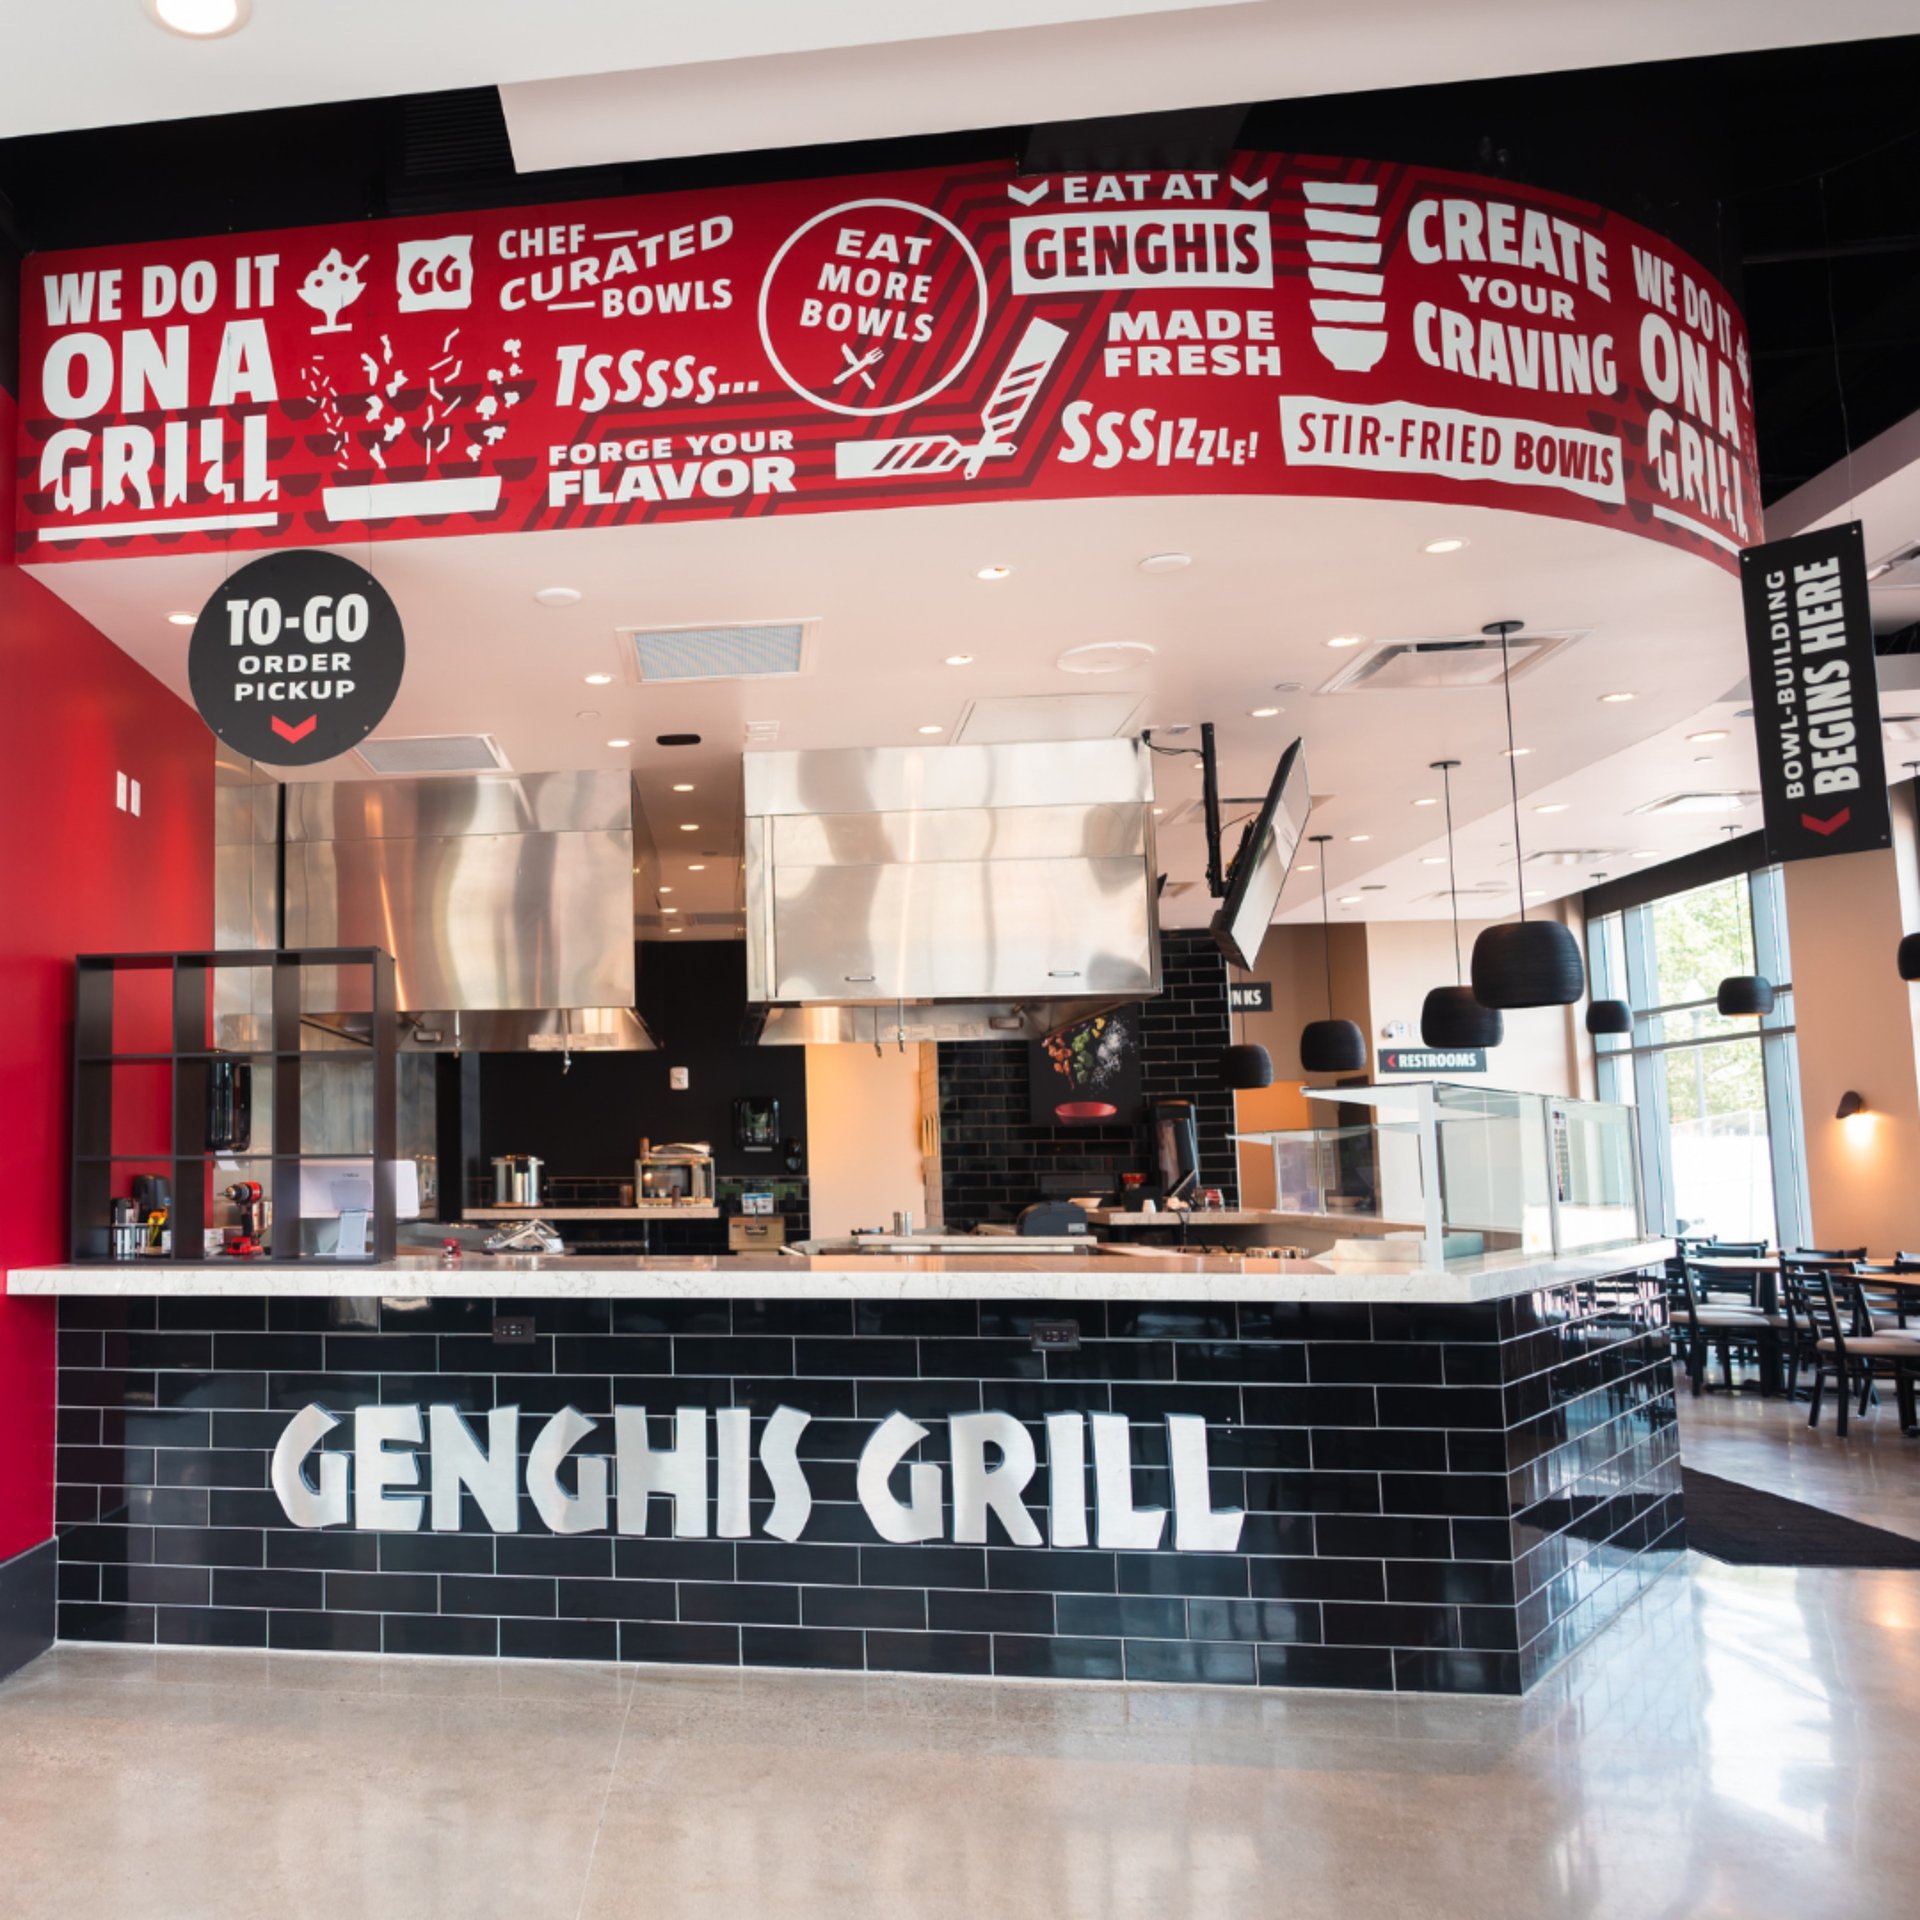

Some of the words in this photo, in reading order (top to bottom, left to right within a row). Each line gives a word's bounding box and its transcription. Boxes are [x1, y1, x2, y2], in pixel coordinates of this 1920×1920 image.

[1063, 173, 1151, 204] EAT
[1162, 173, 1219, 200] AT
[499, 223, 586, 260] CHEF
[499, 215, 734, 312] CURATED
[835, 228, 932, 266] EAT
[1024, 222, 1260, 280] GENGHIS
[1407, 199, 1611, 303] CREATE
[43, 269, 122, 326] WE
[141, 260, 218, 318] DO
[235, 253, 280, 310] IT
[408, 254, 462, 296] GG
[602, 278, 733, 319] BOWLS
[817, 262, 933, 304] MORE
[1458, 274, 1575, 322] YOUR
[799, 298, 934, 343] BOWLS
[1107, 310, 1276, 342] MADE
[1631, 245, 1677, 317] WE
[1682, 273, 1714, 342] DO
[1717, 303, 1733, 361] IT
[42, 325, 190, 420] ON
[208, 318, 279, 407] A
[1103, 344, 1282, 378] FRESH
[1413, 301, 1618, 396] CRAVING
[1639, 312, 1713, 428] ON
[1718, 359, 1741, 452] A
[39, 414, 279, 516] GRILL
[548, 437, 673, 467] FORGE
[685, 429, 794, 457] YOUR
[1297, 411, 1501, 466] STIR-FRIED
[1514, 431, 1614, 487] BOWLS
[548, 455, 797, 508] FLAVOR
[1647, 408, 1750, 544] GRILL
[226, 593, 370, 647] TO-GO
[1793, 556, 1847, 655] HERE
[234, 679, 356, 702] PICKUP
[237, 652, 352, 675] ORDER
[1766, 570, 1806, 799] BOWL-BUILDING
[1802, 659, 1860, 795] BEGINS
[1398, 1052, 1477, 1068] RESTROOMS
[271, 1402, 812, 1543] GENGHIS
[857, 1409, 1246, 1552] GRILL
